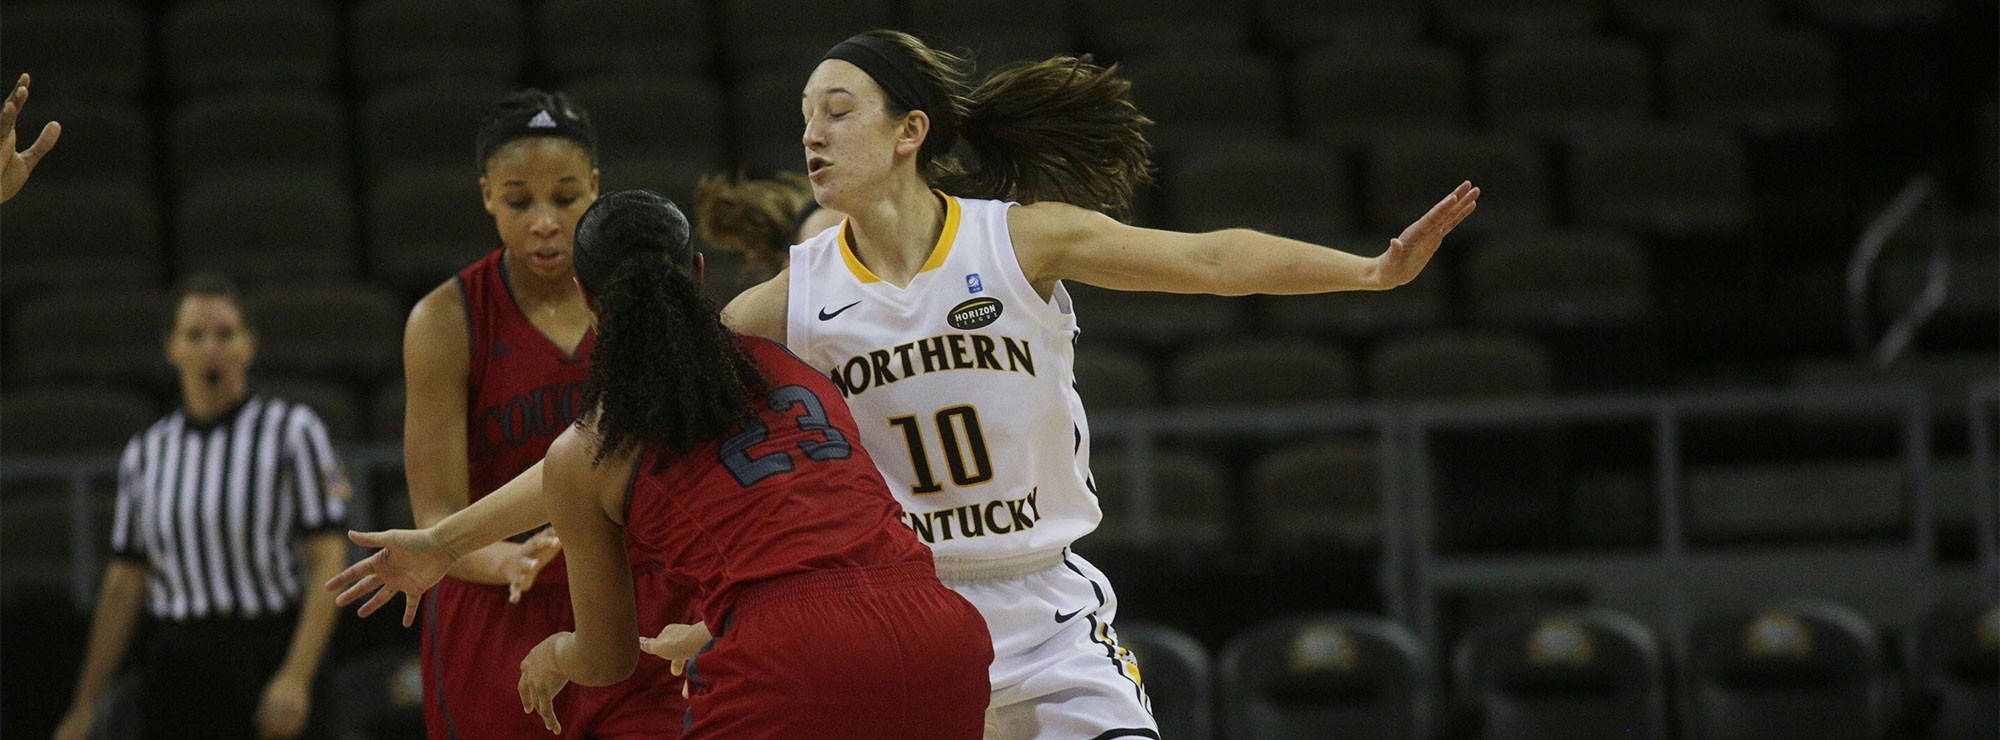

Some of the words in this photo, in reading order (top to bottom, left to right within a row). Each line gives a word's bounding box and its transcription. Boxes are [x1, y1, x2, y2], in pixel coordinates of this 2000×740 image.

[954, 304, 996, 322] HORIZON
[717, 384, 852, 488] 23
[888, 403, 995, 496] 10
[902, 486, 1041, 543] NTUCKY
